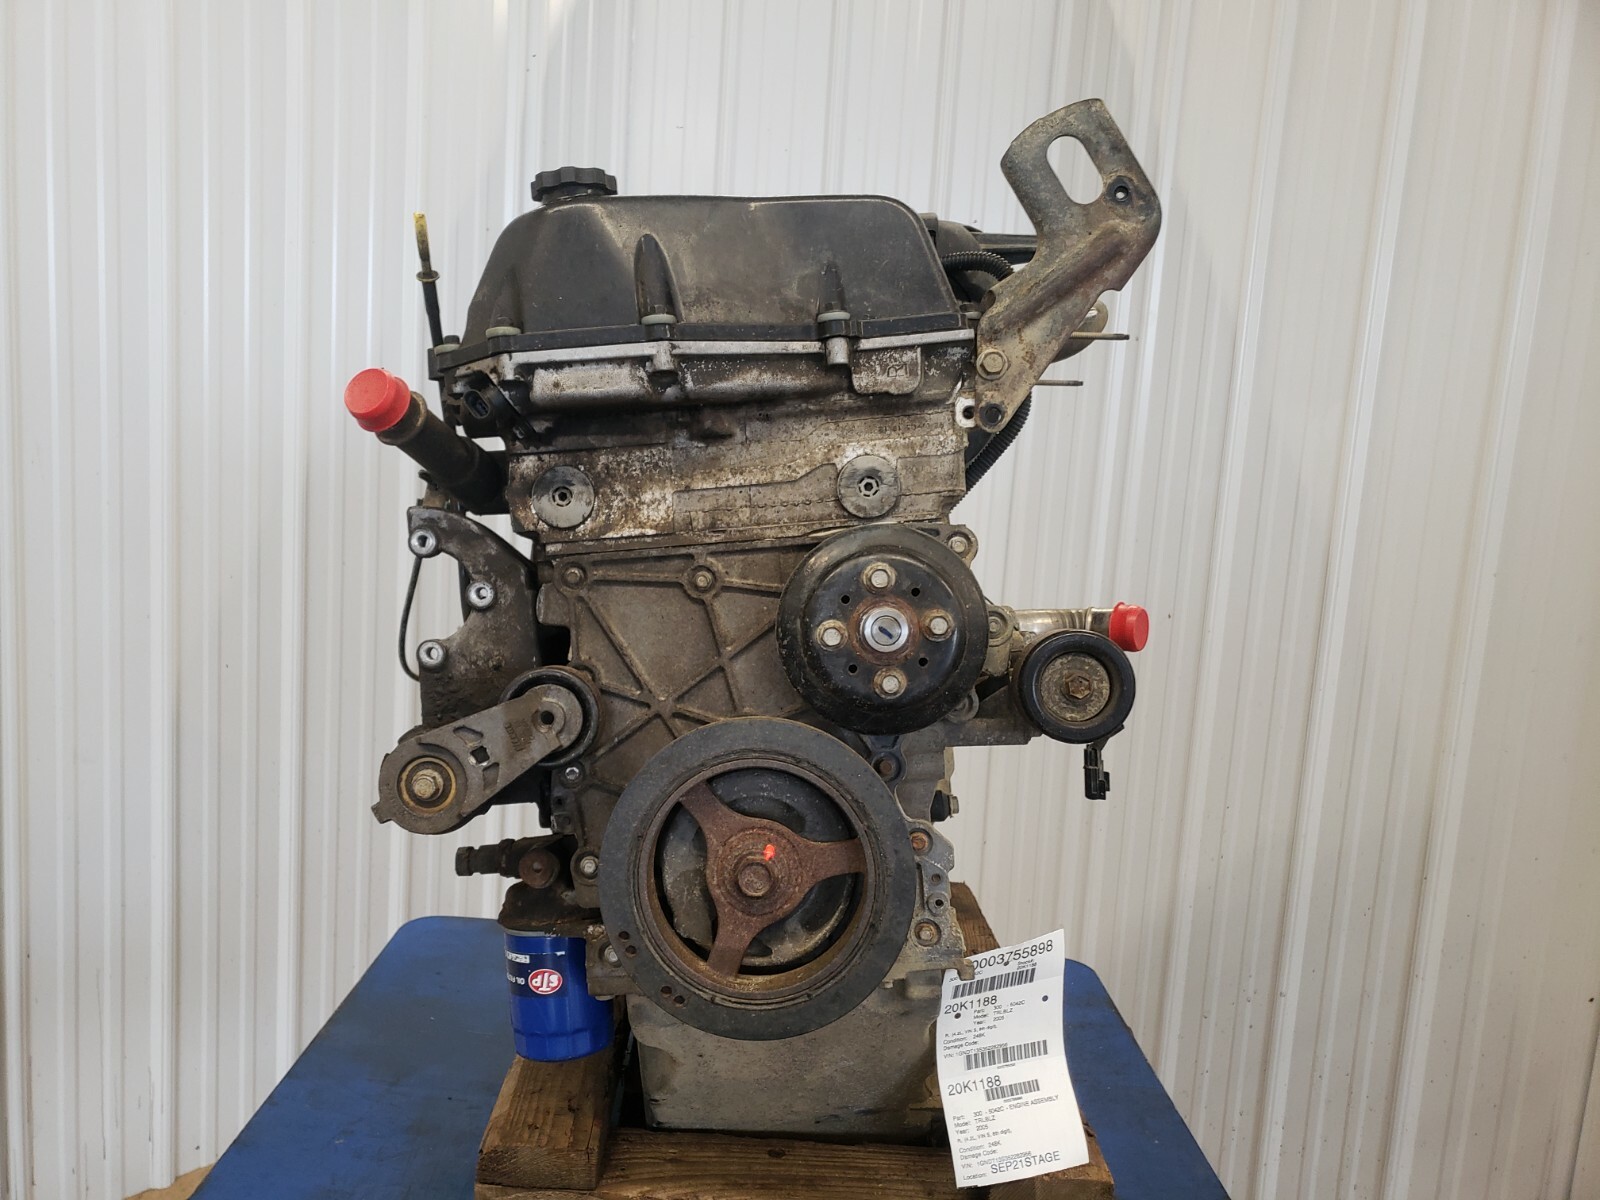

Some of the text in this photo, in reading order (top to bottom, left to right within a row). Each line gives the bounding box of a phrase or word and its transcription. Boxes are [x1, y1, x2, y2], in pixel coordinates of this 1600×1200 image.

[532, 972, 559, 991] STP
[944, 995, 998, 1014] 20K1188
[943, 1043, 963, 1051] Damage
[947, 1075, 1002, 1096] 20K1188
[1009, 1101, 1030, 1111] ENGINE
[1030, 1095, 1059, 1106] ASSEMBLY
[959, 1144, 985, 1154] Condition:
[960, 1149, 998, 1161] Damage Code:
[962, 1150, 1061, 1181] Location: SEP21STAGE
